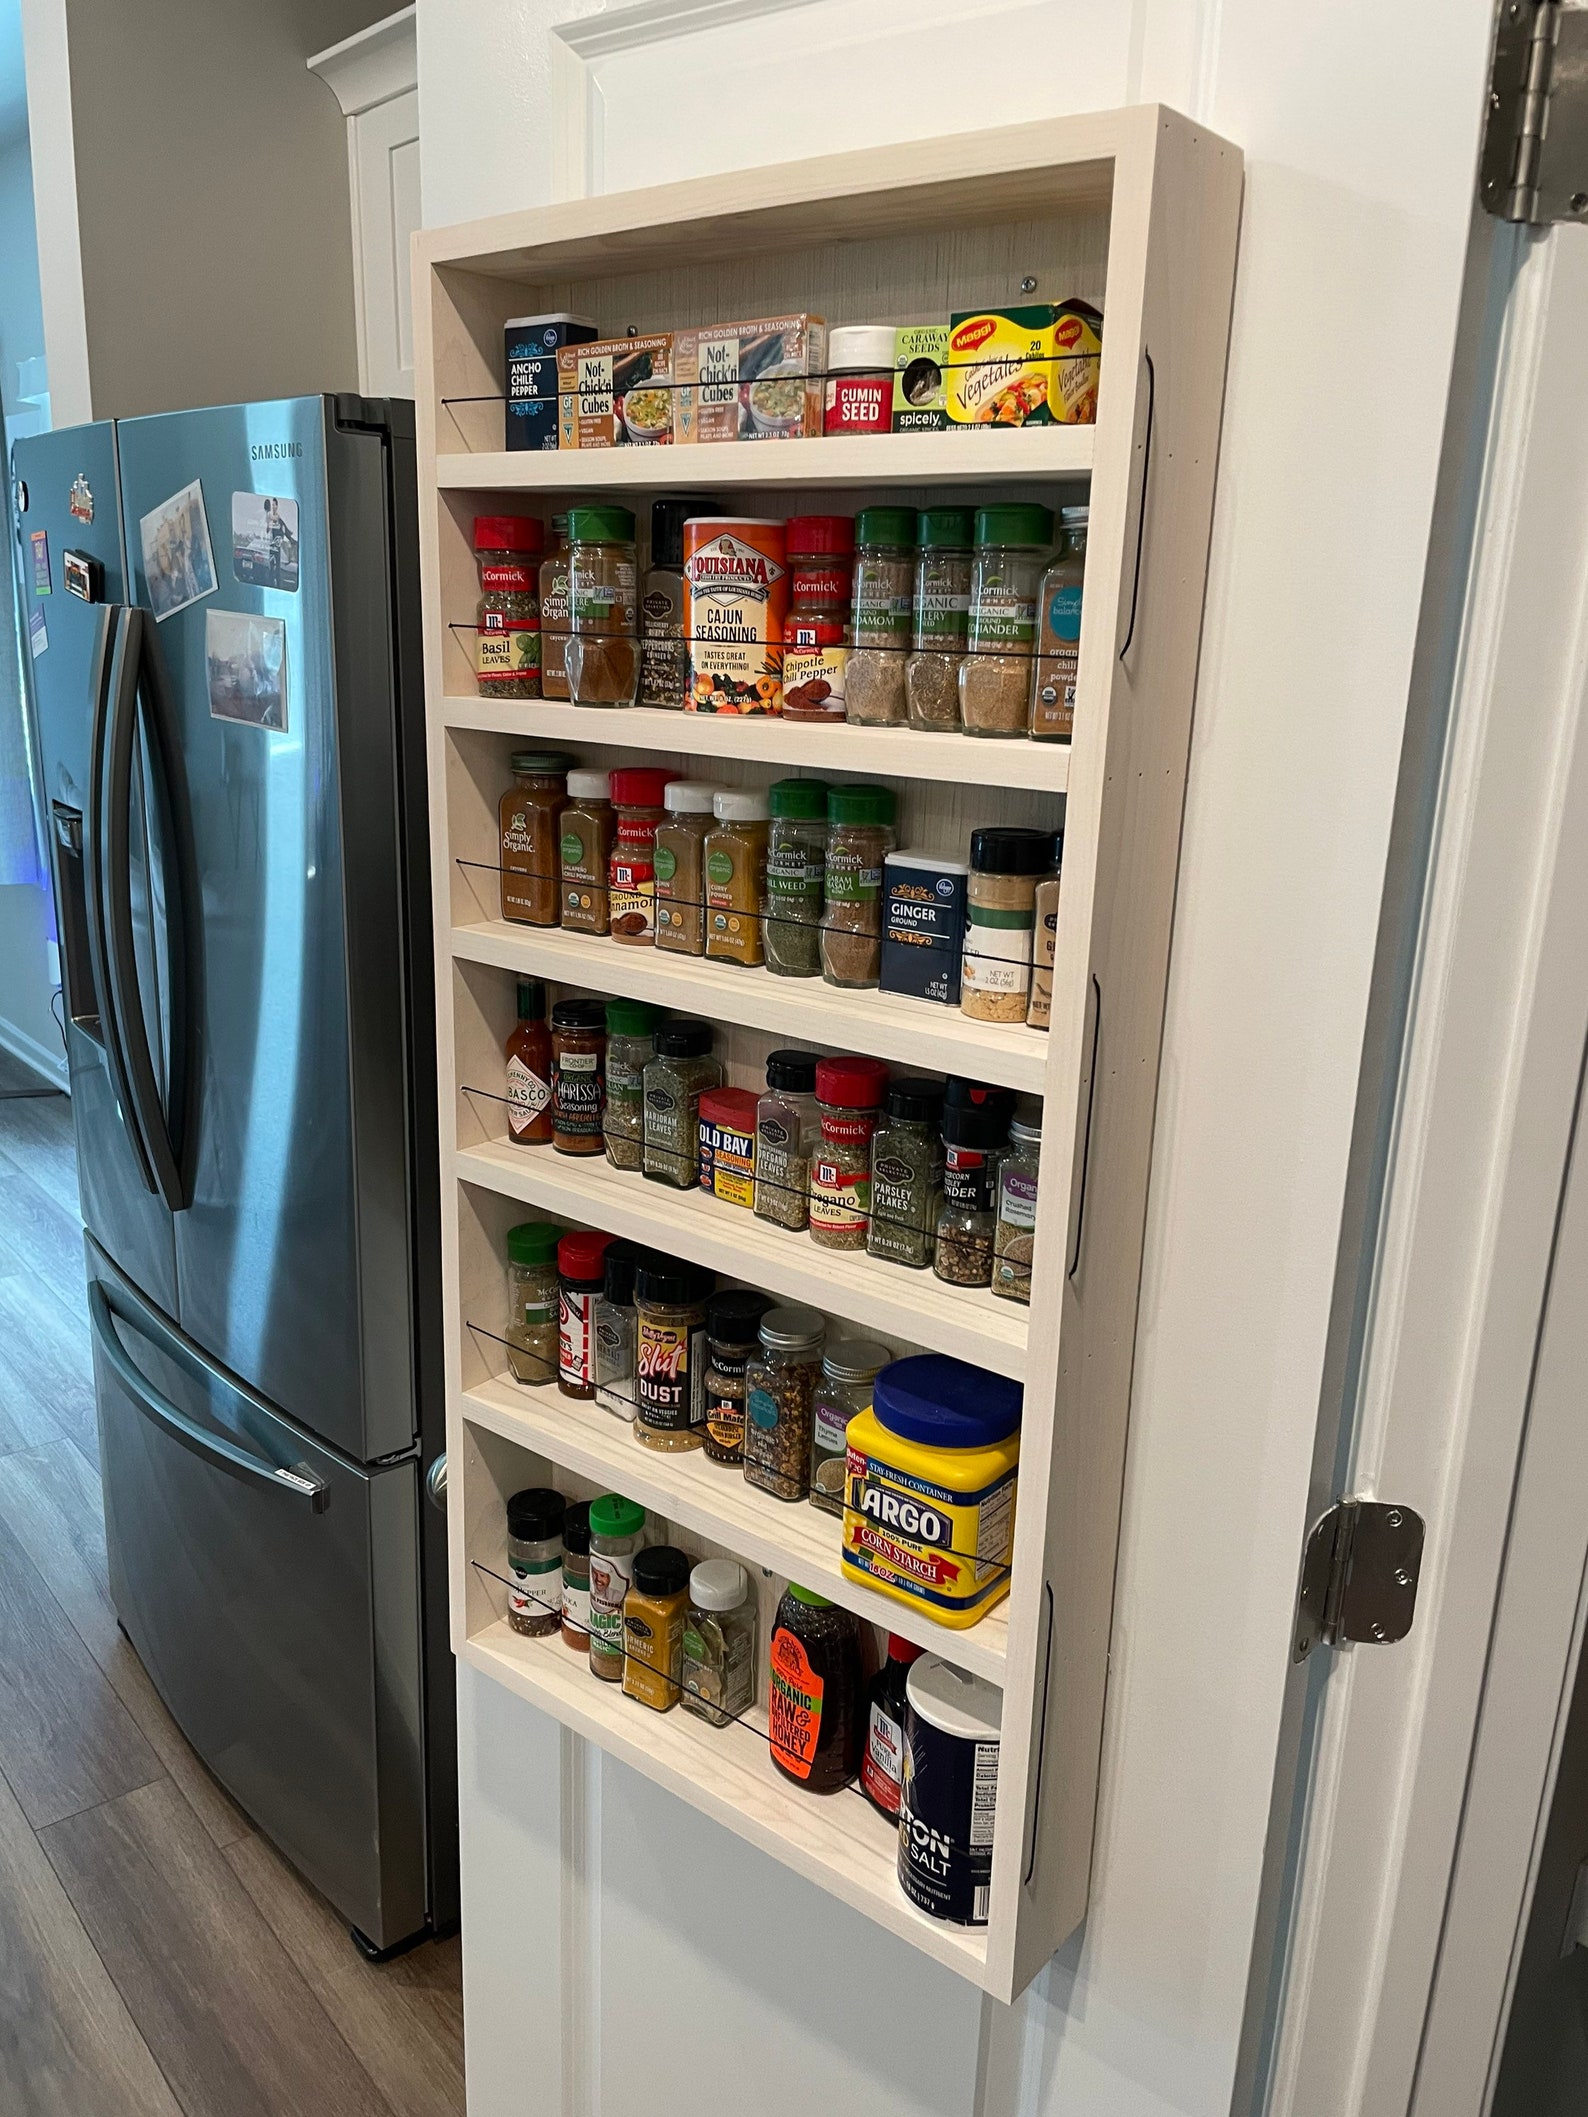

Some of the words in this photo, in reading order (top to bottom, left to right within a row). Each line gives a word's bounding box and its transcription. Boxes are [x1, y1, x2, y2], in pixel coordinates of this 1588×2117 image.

[699, 331, 712, 339] RICH
[714, 328, 738, 337] GOLDEN
[739, 325, 758, 335] BROTH
[902, 333, 948, 344] CARAWAY
[956, 324, 991, 347] Maggi
[578, 348, 590, 356] RICH
[590, 346, 612, 355] GOLDEN
[612, 344, 629, 352] BROTH
[634, 338, 667, 350] SEASONING
[909, 344, 940, 353] SEEDS
[1030, 341, 1041, 350] 20
[707, 346, 730, 363] Not-
[511, 362, 542, 374] ANCHO
[585, 361, 605, 378] Not-
[511, 374, 534, 385] CHILE
[957, 355, 1023, 409] Vegetales
[511, 385, 538, 396] PEPPER
[702, 386, 733, 402] Cubes
[841, 388, 881, 402] CUMIN
[582, 398, 609, 414] Cubes
[842, 402, 879, 421] SEED
[900, 412, 940, 426] spicely
[251, 442, 303, 461] SAMSUNG
[692, 557, 769, 584] LOUISIANA
[794, 581, 837, 593] cCormick
[544, 595, 568, 608] Simpl
[542, 606, 568, 620] Organ
[707, 608, 743, 625] CAJUN
[916, 611, 947, 620] CLERY
[851, 616, 895, 625] DAMOM
[696, 625, 757, 642] SEASONING
[482, 641, 510, 654] Basil
[1050, 648, 1078, 656] organ
[482, 655, 511, 665] LEAVES
[704, 651, 724, 660] TASTES
[727, 652, 746, 661] GREAT
[709, 661, 749, 671] EVERYTHING!
[786, 656, 824, 672] Chipotle
[1057, 661, 1076, 670] chili
[800, 665, 838, 680] Pepper
[1051, 673, 1077, 682] powde
[504, 829, 531, 843] Simply
[503, 839, 533, 853] Organic
[768, 848, 806, 860] cCormick
[825, 851, 863, 865] cCormick
[564, 865, 587, 873] JALAPEÑO
[779, 881, 806, 890] WEED
[827, 874, 851, 883] GARAM
[710, 892, 733, 900] POWDER
[711, 885, 727, 893] CURRY
[891, 904, 936, 922] GINGER
[890, 916, 918, 927] GROUND
[508, 1087, 546, 1101] BASCO
[557, 1081, 601, 1101] HARISSA
[560, 1100, 597, 1113] Seasoning
[649, 1122, 672, 1136] LEAVES
[762, 1125, 783, 1135] PRIVATE
[822, 1121, 865, 1135] cCormick
[700, 1124, 720, 1148] OLD
[723, 1133, 748, 1157] BAY
[715, 1149, 751, 1167] SEASONING
[759, 1150, 788, 1168] OREGANO
[761, 1160, 784, 1176] LEAVES
[879, 1167, 910, 1179] SELECTION
[880, 1162, 908, 1174] PRIVATE
[874, 1182, 912, 1200] PARSLEY
[944, 1185, 976, 1198] NDER
[1010, 1178, 1037, 1193] Organ
[877, 1194, 908, 1211] FLAKES
[1006, 1200, 1032, 1211] Crushed
[814, 1205, 841, 1216] LEAVES
[874, 1235, 881, 1244] WT
[893, 1240, 899, 1249] OZ
[638, 1343, 687, 1378] Slut
[712, 1356, 744, 1373] cCormi
[640, 1378, 682, 1403] DUST
[724, 1413, 743, 1423] Mate
[821, 1408, 848, 1425] Organic
[818, 1424, 838, 1438] Thyme
[818, 1431, 838, 1445] Leaves
[869, 1462, 908, 1486] STAY-FRESH
[908, 1478, 953, 1503] CONTAINER
[862, 1488, 940, 1542] ARGO
[882, 1530, 900, 1544] 100%
[902, 1539, 923, 1552] PURE
[861, 1529, 891, 1554] CORN
[893, 1545, 937, 1578] STARCH
[772, 1670, 811, 1711] ORGANIC
[772, 1685, 795, 1722] RAW
[796, 1711, 811, 1727] &
[772, 1707, 810, 1742] UNFILTERED
[773, 1723, 807, 1756] HONEY
[872, 1742, 897, 1774] Vanilla
[911, 1843, 951, 1877] SALT
